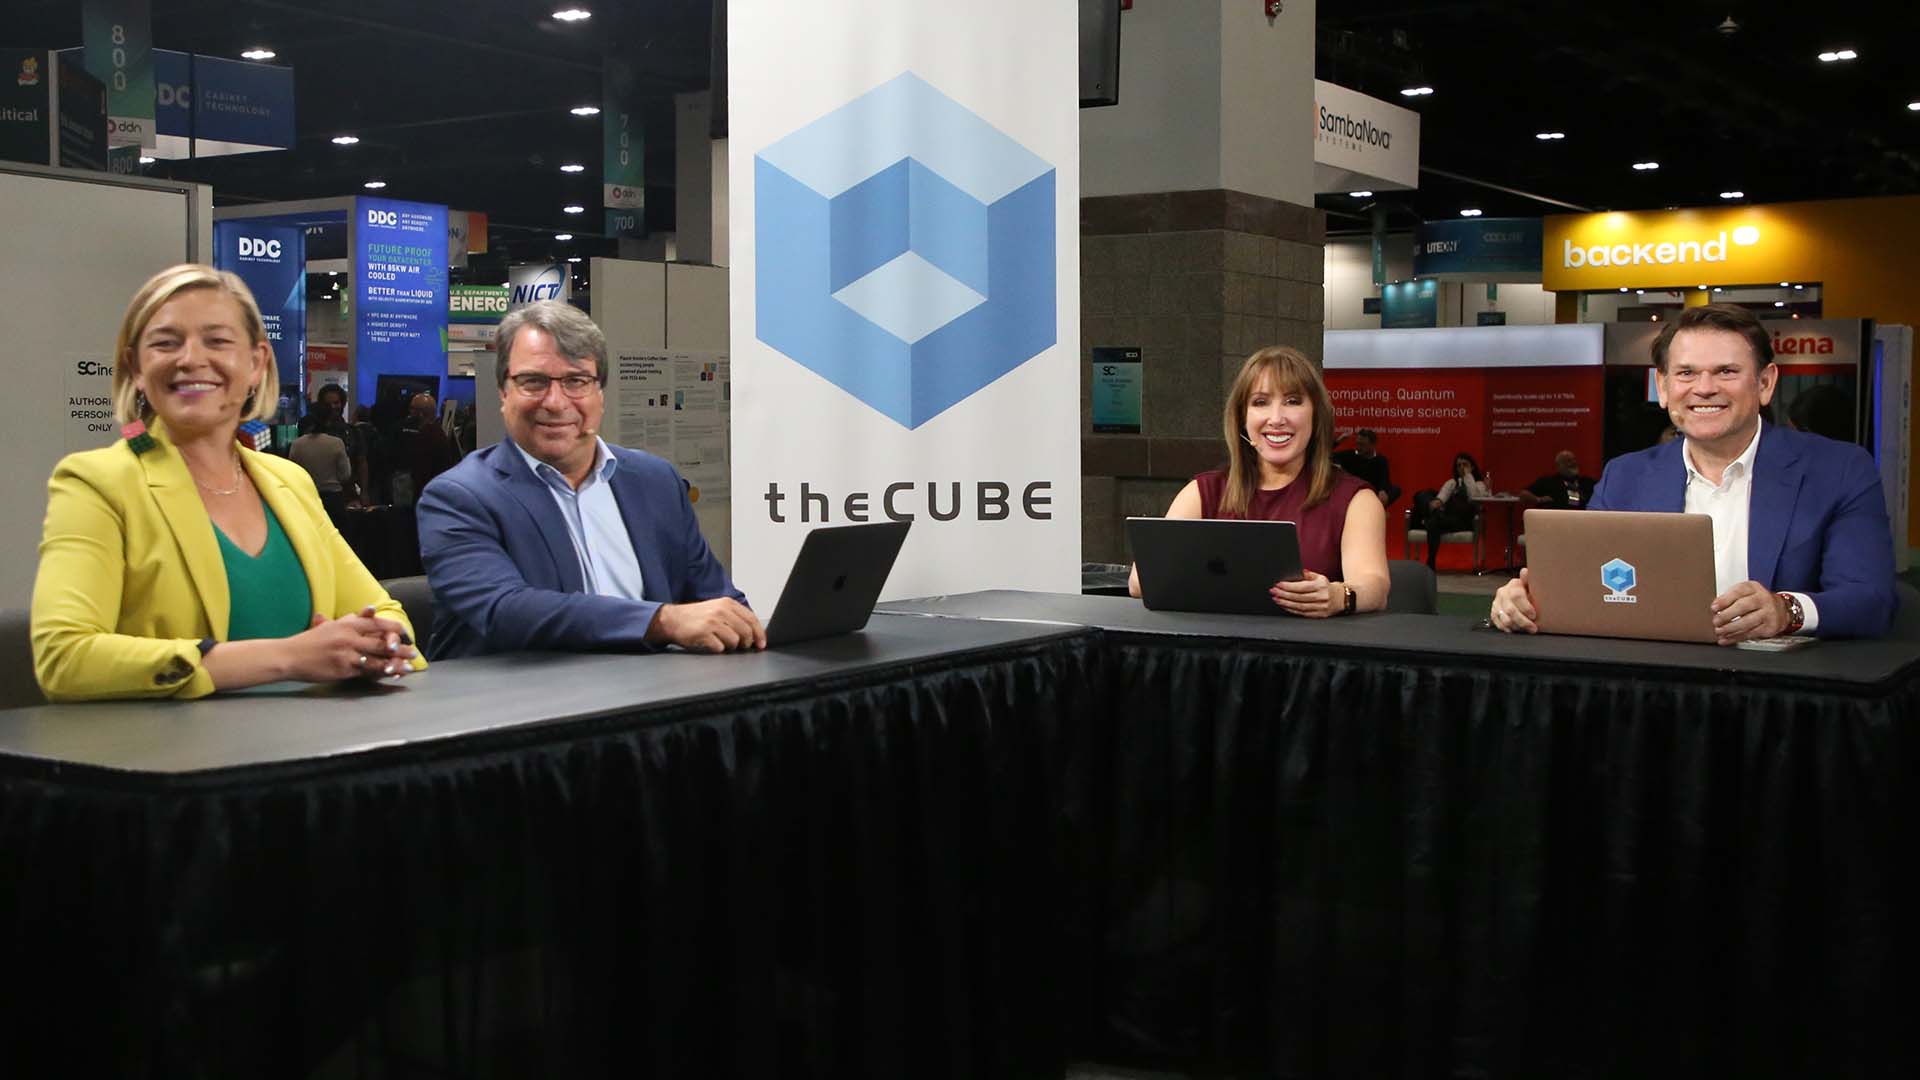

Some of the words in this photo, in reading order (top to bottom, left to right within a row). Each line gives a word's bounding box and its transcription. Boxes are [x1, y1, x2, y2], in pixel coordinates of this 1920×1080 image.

[112, 24, 126, 91] 800
[205, 101, 271, 119] TECHNOLOGY
[118, 121, 142, 133] ddn
[1319, 106, 1390, 149] SambaNova
[620, 114, 629, 165] 700
[368, 209, 397, 225] DDC
[613, 215, 634, 230] 700
[239, 237, 281, 258] DDC
[368, 243, 403, 254] FUTURE
[404, 246, 433, 257] PROOF
[1564, 231, 1727, 268] backend
[368, 254, 386, 262] YOUR
[388, 255, 432, 265] DATACENTER
[368, 263, 386, 271] WITH
[408, 265, 420, 273] AIR
[368, 271, 396, 280] COOLED
[368, 286, 395, 296] BETTER
[411, 289, 433, 298] LIQUID
[512, 283, 560, 304] NICT
[449, 296, 510, 312] ENERG
[69, 397, 112, 406] AUTHORI
[1396, 388, 1455, 400] Quantum
[88, 423, 113, 432] ONLY
[764, 481, 1052, 523] theCUBE
